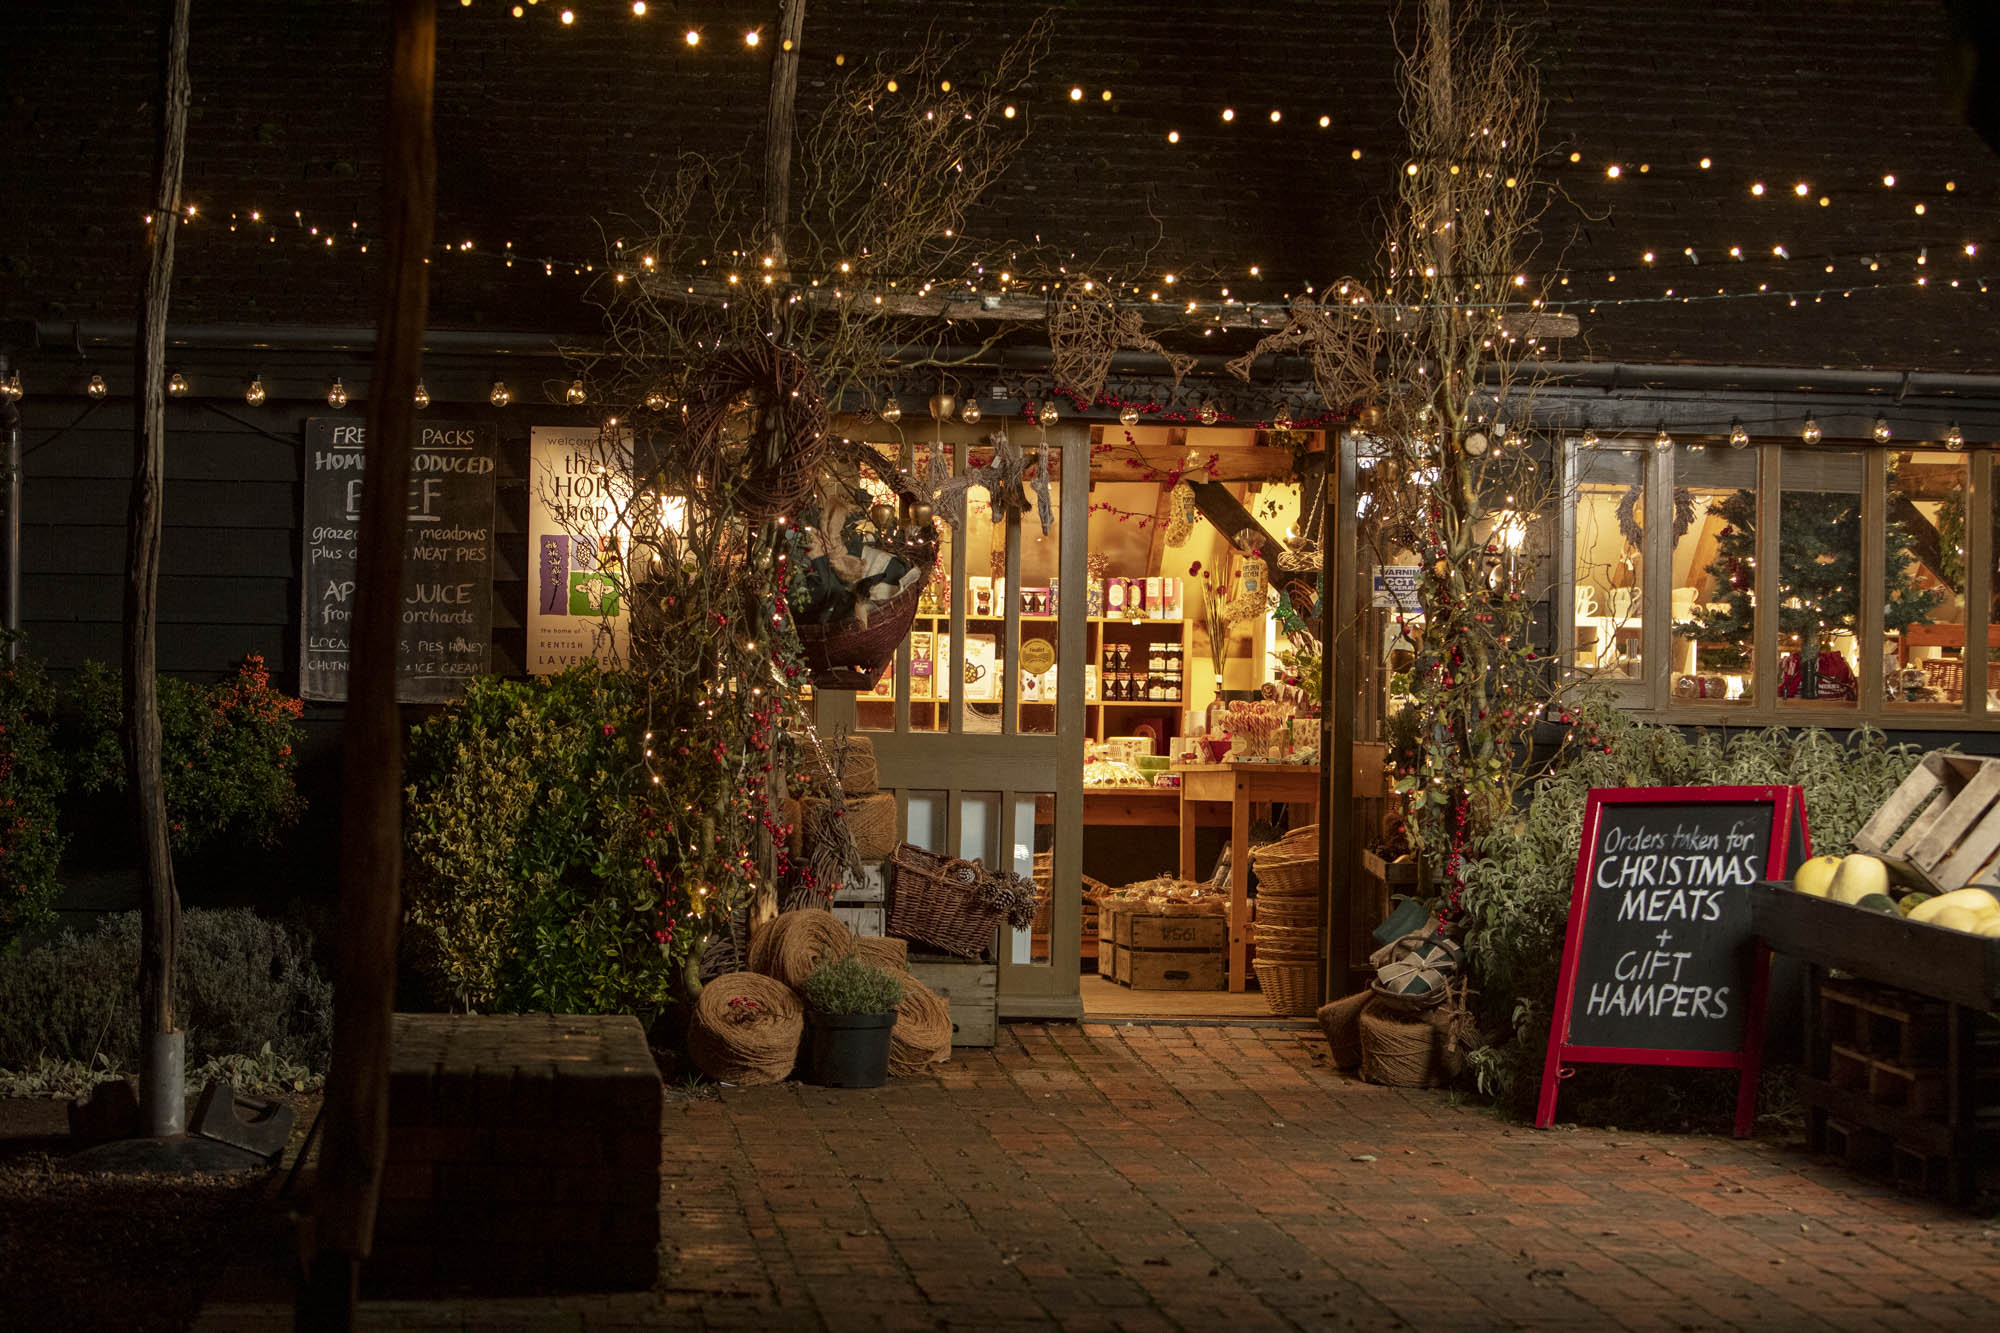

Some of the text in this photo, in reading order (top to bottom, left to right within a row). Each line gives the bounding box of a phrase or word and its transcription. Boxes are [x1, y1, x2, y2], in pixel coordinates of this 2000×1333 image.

[422, 428, 475, 445] PACKS
[315, 451, 494, 474] HOM ODUCED
[565, 452, 601, 475] the
[346, 478, 442, 514] BF
[554, 499, 608, 529] shop
[420, 523, 487, 541] meadows
[311, 546, 342, 563] plus
[413, 546, 451, 561] MEAT
[456, 547, 487, 562] PIES
[405, 582, 475, 604] JUICE
[402, 608, 473, 624] orchards
[309, 635, 351, 649] LOCA
[540, 640, 583, 649] KENTISH
[415, 661, 435, 673] ICE
[440, 662, 484, 673] CREAM
[539, 655, 617, 665] LAVENER
[1604, 821, 1755, 854] Orders taken for
[1596, 855, 1759, 889] CHRISTMAS
[1617, 888, 1725, 922] MEATS
[1655, 928, 1673, 947] +
[1614, 950, 1692, 982] GIFT
[1586, 982, 1730, 1019] HAMPERS
